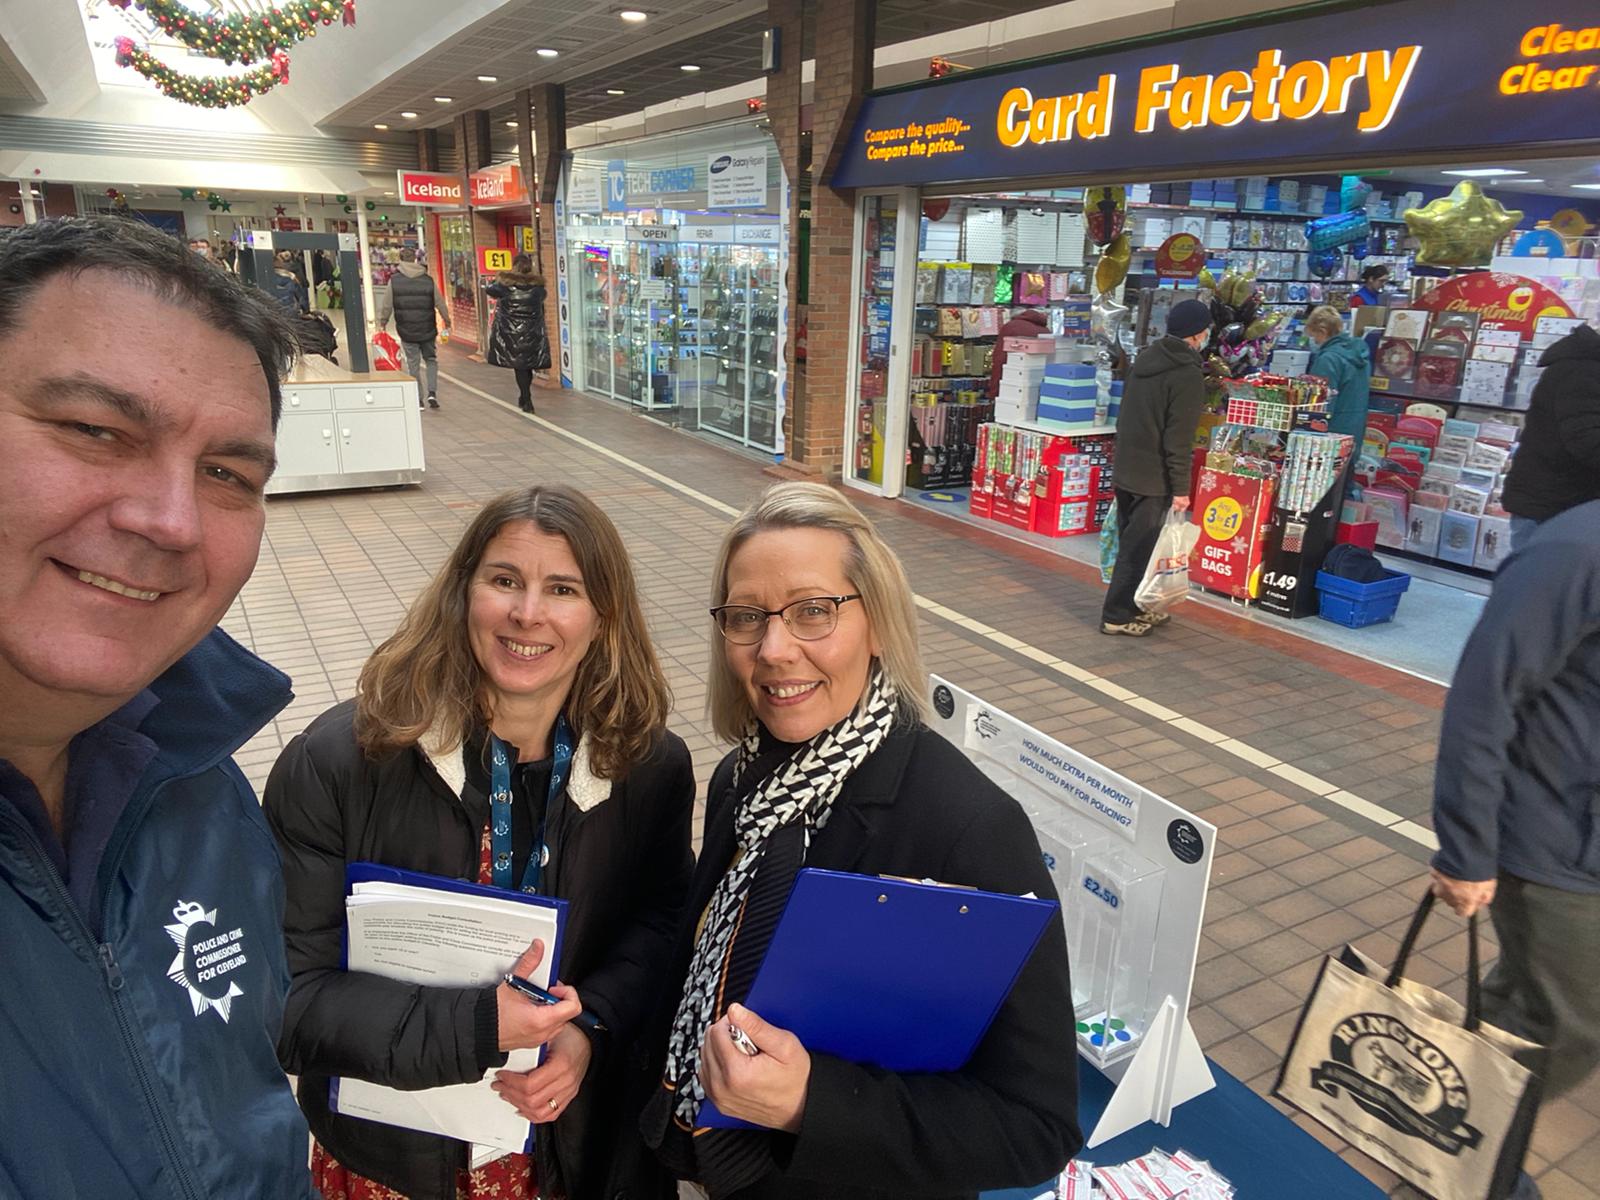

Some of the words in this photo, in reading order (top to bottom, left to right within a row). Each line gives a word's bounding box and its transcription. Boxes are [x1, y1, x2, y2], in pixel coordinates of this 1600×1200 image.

[1520, 24, 1600, 57] Clea
[1499, 62, 1597, 95] Clear
[997, 74, 1116, 147] Card
[1134, 45, 1422, 133] Factory
[864, 128, 905, 145] Compare
[906, 122, 923, 138] the
[925, 117, 971, 139] quality...
[867, 145, 908, 162] Compare
[909, 139, 926, 155] the
[927, 137, 965, 158] price...
[407, 181, 461, 198] Iceland
[477, 174, 504, 200] Iceland
[608, 172, 624, 202] TC
[642, 229, 667, 239] OPEN
[491, 253, 505, 267] £1
[1206, 507, 1217, 523] 3
[1224, 513, 1238, 529] £1
[1204, 545, 1232, 562] GIFT
[1201, 558, 1232, 577] BAGS
[1262, 571, 1297, 591] £1.49
[1022, 738, 1040, 753] HOW
[1040, 749, 1062, 767] MUCH
[1063, 763, 1085, 781] EXTRA
[1086, 776, 1101, 790] PER
[1101, 785, 1133, 808] MONTH
[1019, 754, 1045, 774] WOULD
[1045, 769, 1060, 784] YOU
[1060, 780, 1074, 793] PAY
[1075, 789, 1090, 803] FOR
[1091, 798, 1132, 827] POLICING?
[1084, 876, 1118, 908] £2.50
[192, 937, 217, 955] POLICE
[215, 933, 229, 946] AND
[195, 942, 242, 969] COMMISSIONER
[197, 968, 217, 983] FOR
[216, 954, 247, 975] CLEVELAND
[1333, 1015, 1467, 1109] RINGTONS
